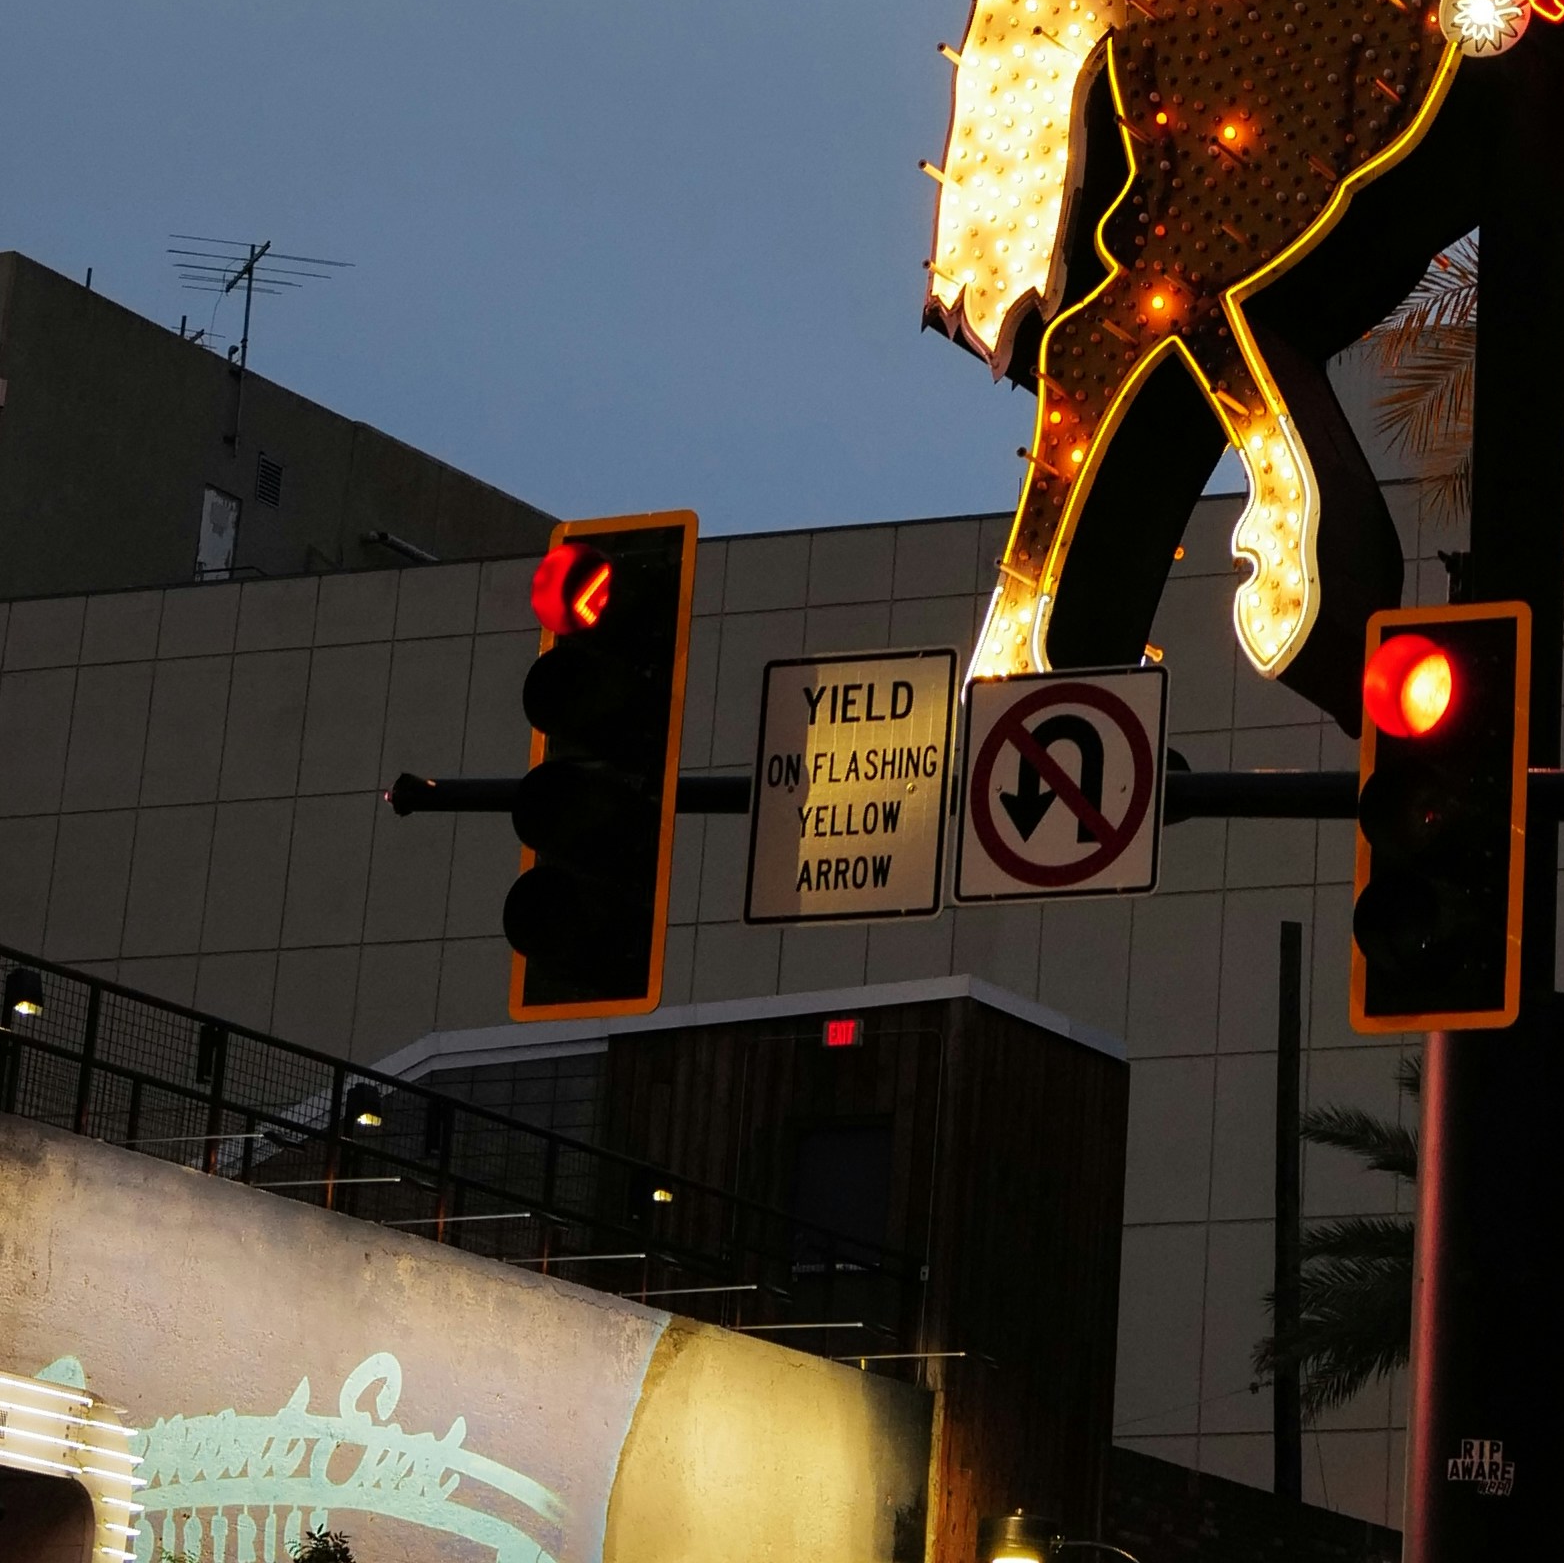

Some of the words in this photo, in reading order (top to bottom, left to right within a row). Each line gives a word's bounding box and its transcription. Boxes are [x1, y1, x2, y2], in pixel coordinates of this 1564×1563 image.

[802, 680, 914, 726] YIELD
[767, 753, 802, 787] ON
[812, 744, 938, 784] FLASHING
[797, 799, 902, 838] YELLOW
[795, 854, 892, 892] ARROW
[828, 1020, 857, 1046] EXIT
[1463, 1441, 1501, 1460] RIP
[1449, 1460, 1513, 1481] AWARE
